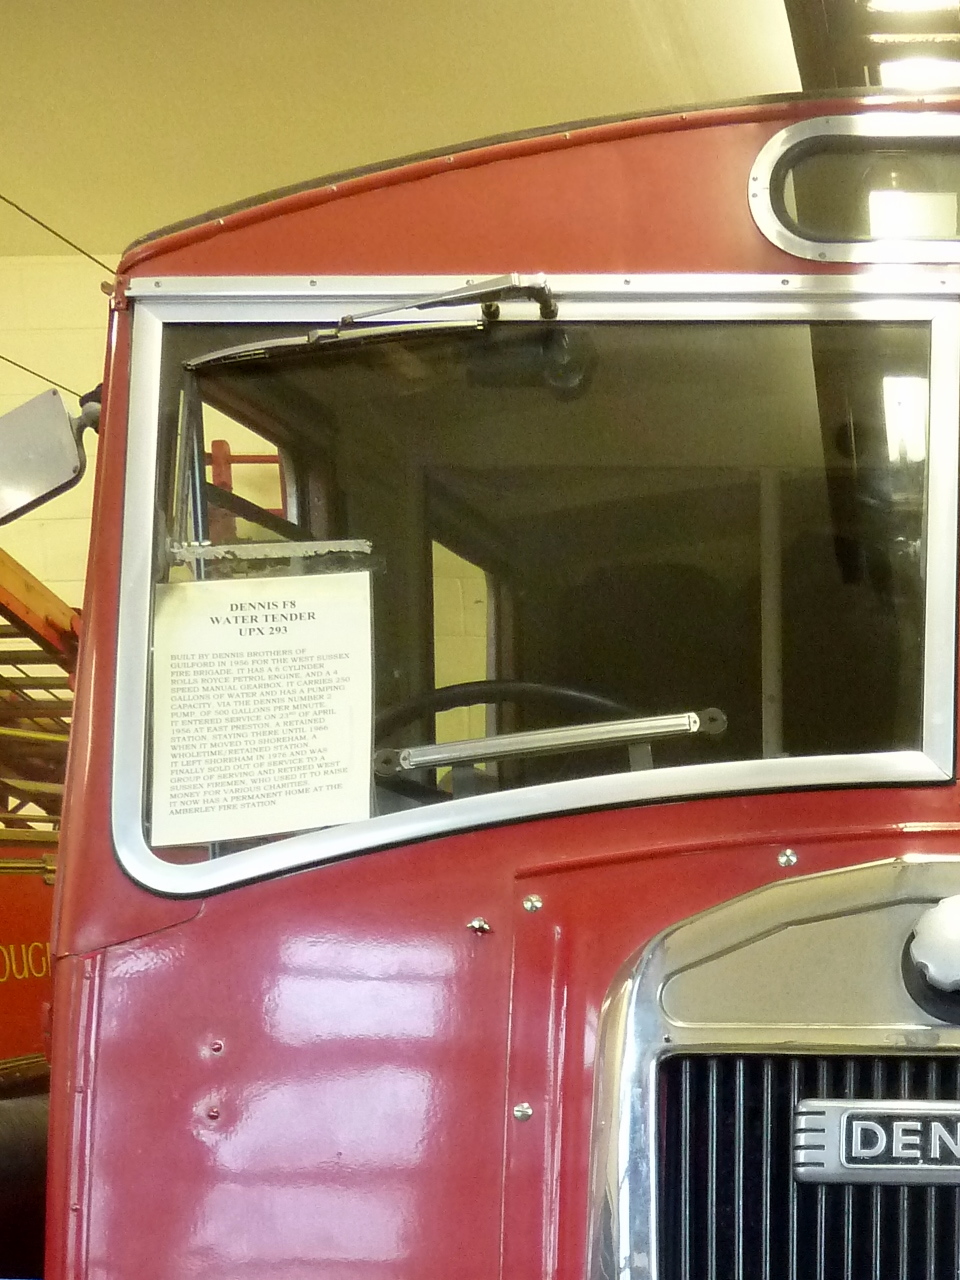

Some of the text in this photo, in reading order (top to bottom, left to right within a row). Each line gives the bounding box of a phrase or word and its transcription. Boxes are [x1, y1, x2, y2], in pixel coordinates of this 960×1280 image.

[230, 600, 296, 612] DENNIS F8
[209, 612, 316, 625] WATER TENDER
[238, 626, 288, 636] UPX 293
[170, 653, 196, 661] BUILT
[212, 651, 245, 659] DENNIS
[246, 649, 293, 658] BROTHERS
[230, 659, 250, 667] 1956
[251, 658, 269, 666] FOR
[270, 657, 289, 665] THE
[290, 655, 315, 663] WEST
[316, 653, 350, 661] SUSSEX
[170, 670, 191, 678] FIRE
[236, 667, 246, 675] IT
[282, 663, 325, 672] CYLINDER
[170, 677, 199, 686] ROLLS
[200, 676, 230, 685] ROYCE
[232, 675, 266, 683] PETROL
[170, 686, 200, 694] SPEED
[201, 684, 238, 693] MANUAL
[296, 678, 334, 687] CARRIES
[335, 676, 351, 684] 250
[170, 693, 211, 702] GALLONS
[226, 691, 257, 699] WATER
[279, 688, 297, 696] HAS
[307, 684, 346, 693] PUMPING
[216, 700, 232, 708] VIA
[233, 699, 251, 707] THE
[253, 697, 286, 706] DENNIS
[287, 694, 325, 703] NUMBER
[181, 717, 222, 727] ENTERED
[224, 714, 262, 724] SERVICE
[298, 710, 311, 718] OF
[312, 708, 336, 716] APRIL
[199, 709, 212, 717] OF
[231, 706, 271, 715] GALLONS
[273, 704, 290, 712] PER
[172, 727, 191, 735] 1956
[193, 726, 205, 734] AT
[206, 725, 229, 733] EAST
[282, 717, 326, 727] RETAINED
[212, 731, 249, 741] STAYING
[250, 729, 280, 738] THERE
[282, 727, 307, 735] UNTIL
[310, 725, 329, 733] 1966
[170, 743, 197, 752] WHEN
[199, 742, 208, 750] IT
[209, 740, 242, 749] MOVED
[170, 760, 179, 768] IT
[180, 759, 203, 767] LEFT
[204, 755, 254, 765] SHOREHAM
[289, 749, 308, 757] AND
[309, 747, 328, 755] WAS
[169, 775, 201, 784] GROUP
[217, 770, 255, 780] SERVING
[257, 768, 276, 776] AND
[277, 764, 315, 774] RETIRED
[316, 760, 341, 769] WEST
[170, 766, 205, 776] FINALLY
[207, 765, 231, 773] SOLD
[232, 763, 251, 771] OUT
[252, 761, 265, 769] OF
[267, 757, 304, 767] SERVICE
[305, 755, 318, 763] TO
[169, 782, 204, 792] SUSSEX
[250, 776, 272, 785] WHO
[273, 773, 297, 782] USED
[309, 770, 321, 778] TO
[323, 767, 348, 776] RAISE
[169, 791, 201, 800] MONEY
[203, 789, 221, 797] FOR
[223, 785, 262, 795] VARIOUS
[169, 800, 178, 808] IT
[179, 798, 200, 807] NOW
[202, 797, 220, 805] HAS
[230, 791, 283, 802] PERMANENT
[284, 787, 311, 796] HOME
[325, 783, 343, 791] THE
[168, 805, 216, 817] AMBERLEY
[218, 803, 238, 811] FIRE
